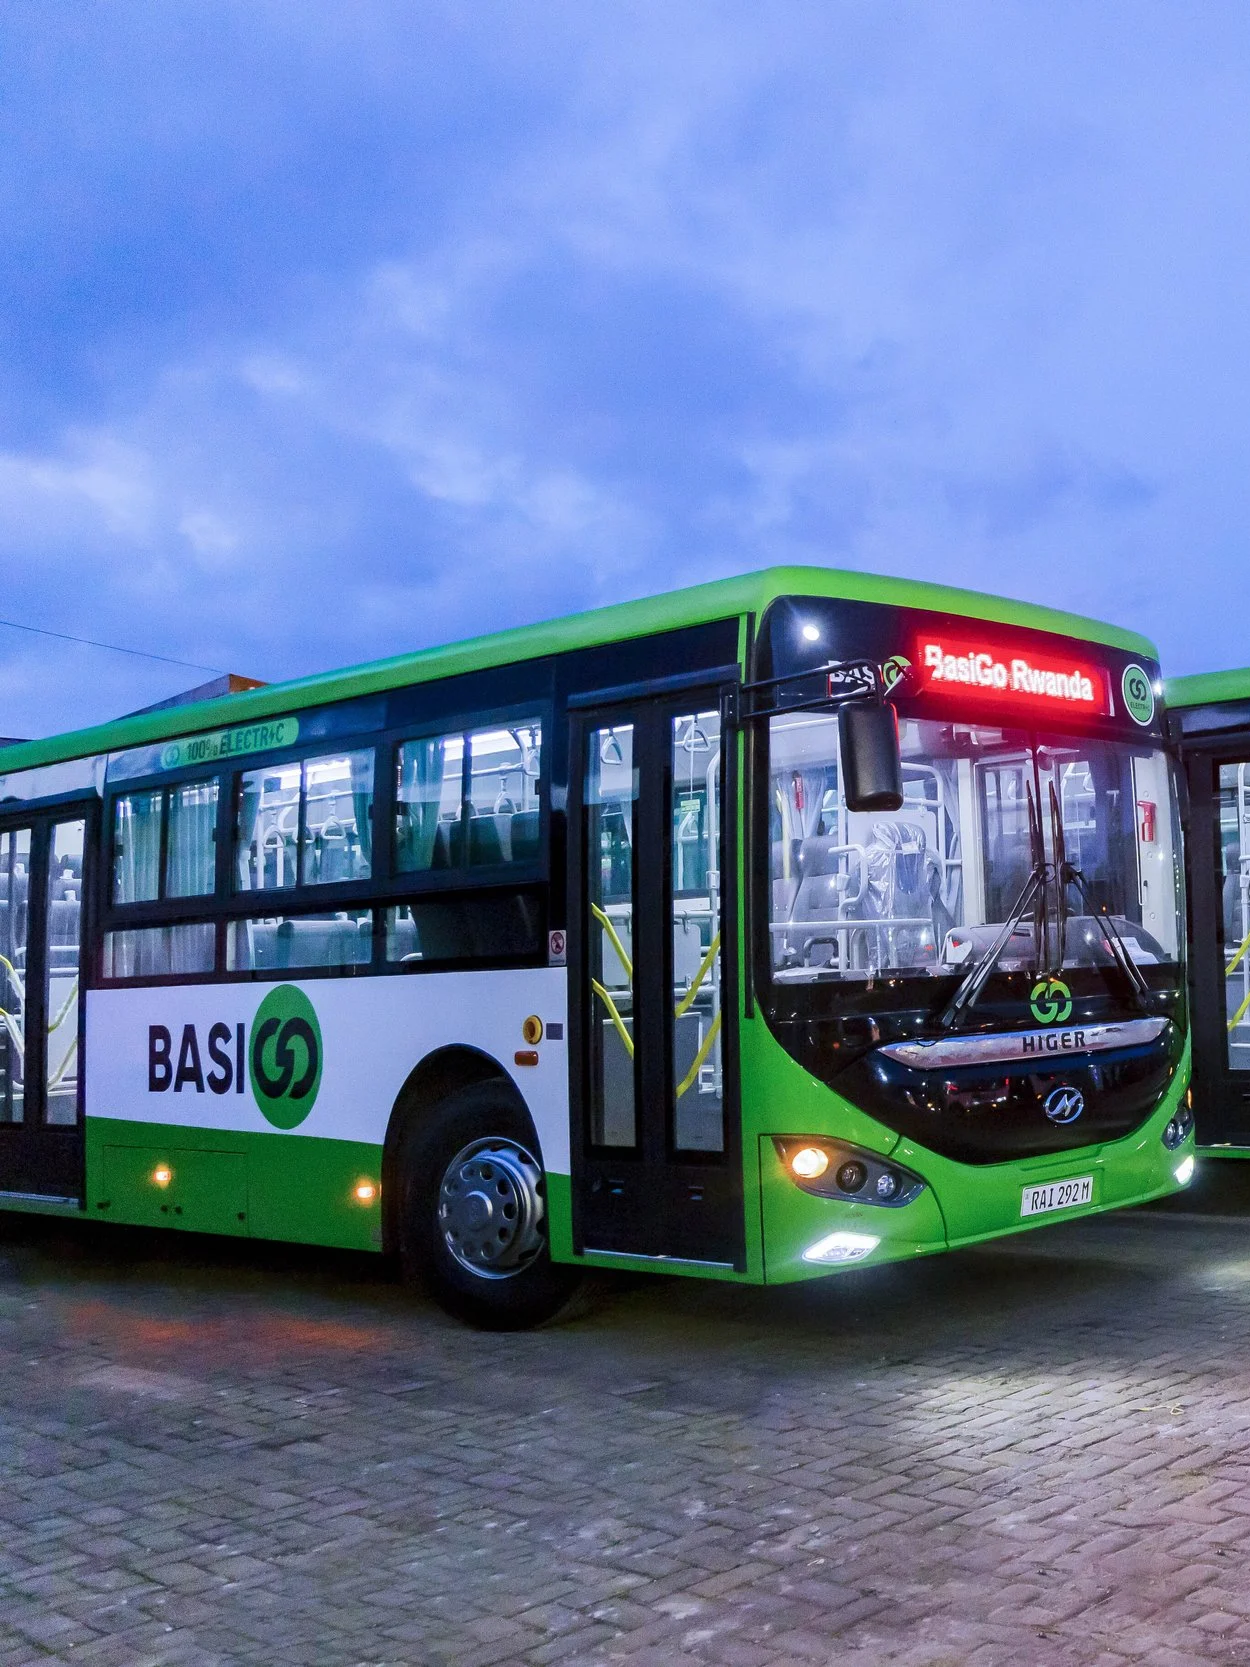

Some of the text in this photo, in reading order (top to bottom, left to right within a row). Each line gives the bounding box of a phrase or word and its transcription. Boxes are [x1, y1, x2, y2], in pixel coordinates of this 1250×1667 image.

[924, 645, 1094, 701] BasiGo Rwanda
[1023, 1030, 1086, 1053] HIGER
[1057, 1183, 1079, 1205] 292
[1081, 1180, 1090, 1200] M
